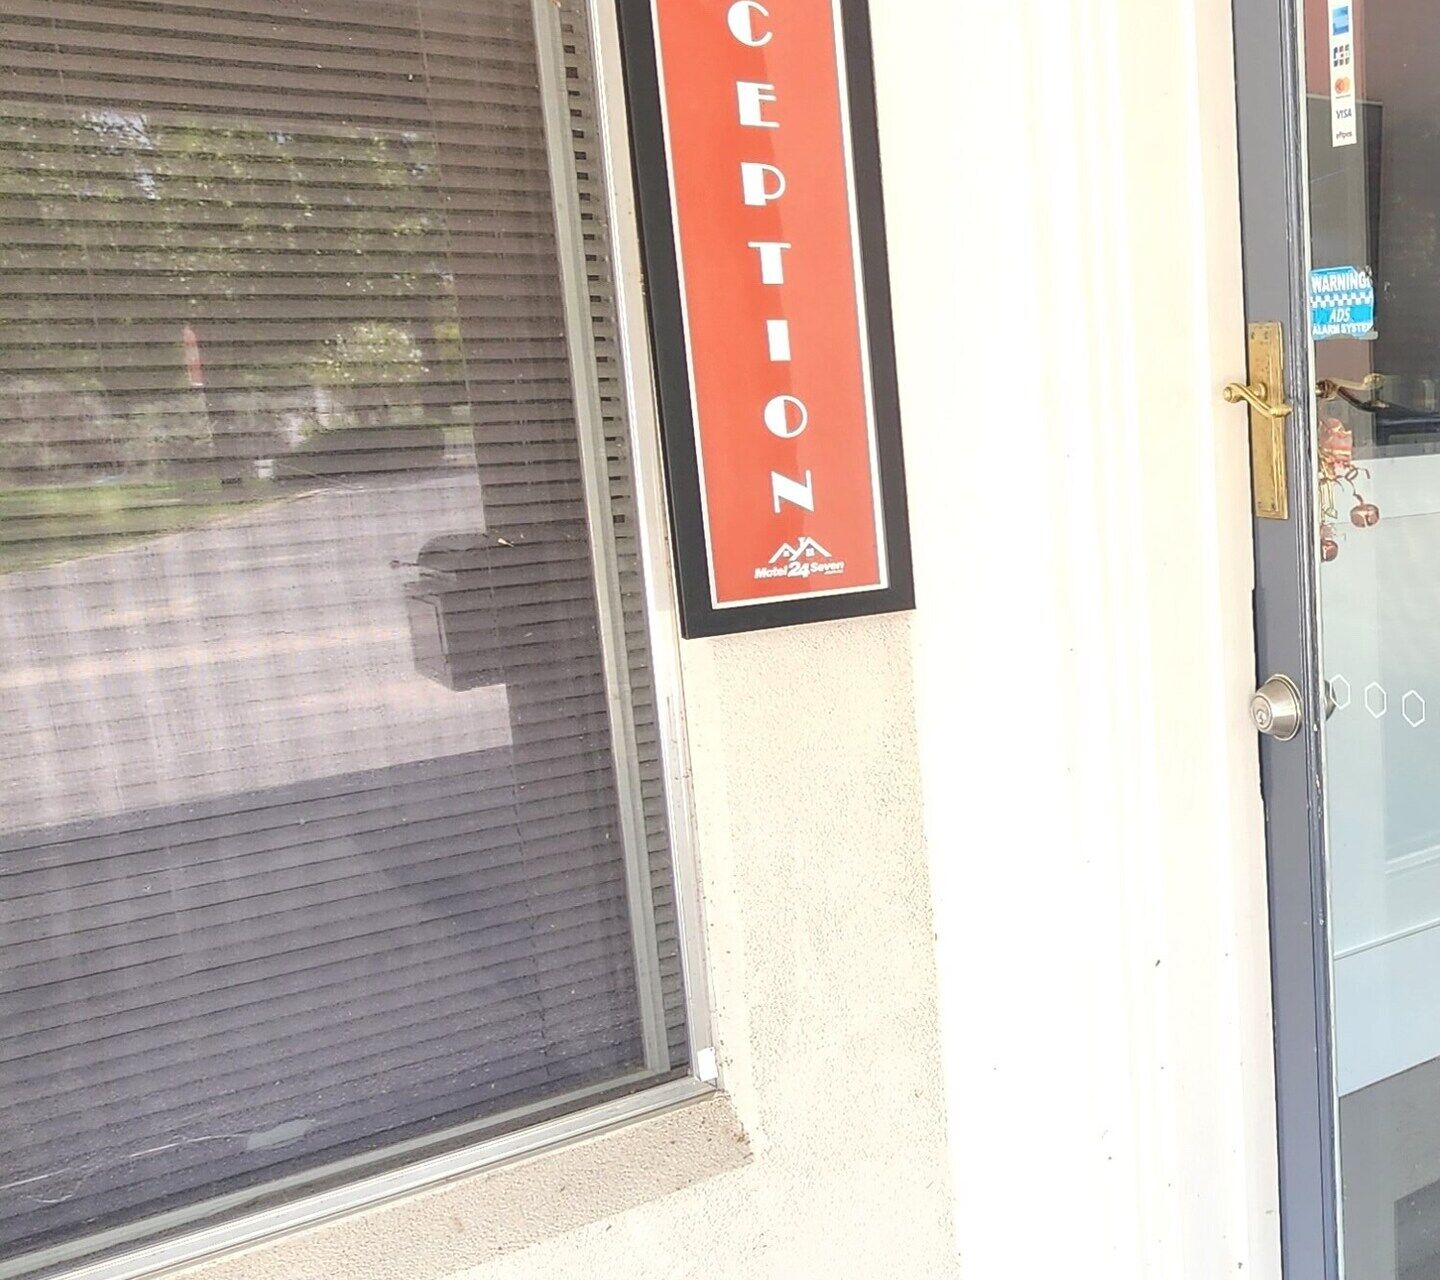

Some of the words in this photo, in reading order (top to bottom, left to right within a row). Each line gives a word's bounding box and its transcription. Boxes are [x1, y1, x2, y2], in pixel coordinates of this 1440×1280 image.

[1336, 108, 1352, 119] VISA
[1312, 272, 1369, 292] WARNING
[1329, 307, 1351, 322] ADS
[1312, 323, 1340, 335] ALARM
[754, 565, 788, 579] Motel
[787, 561, 811, 578] 24
[810, 561, 845, 573] Seven
